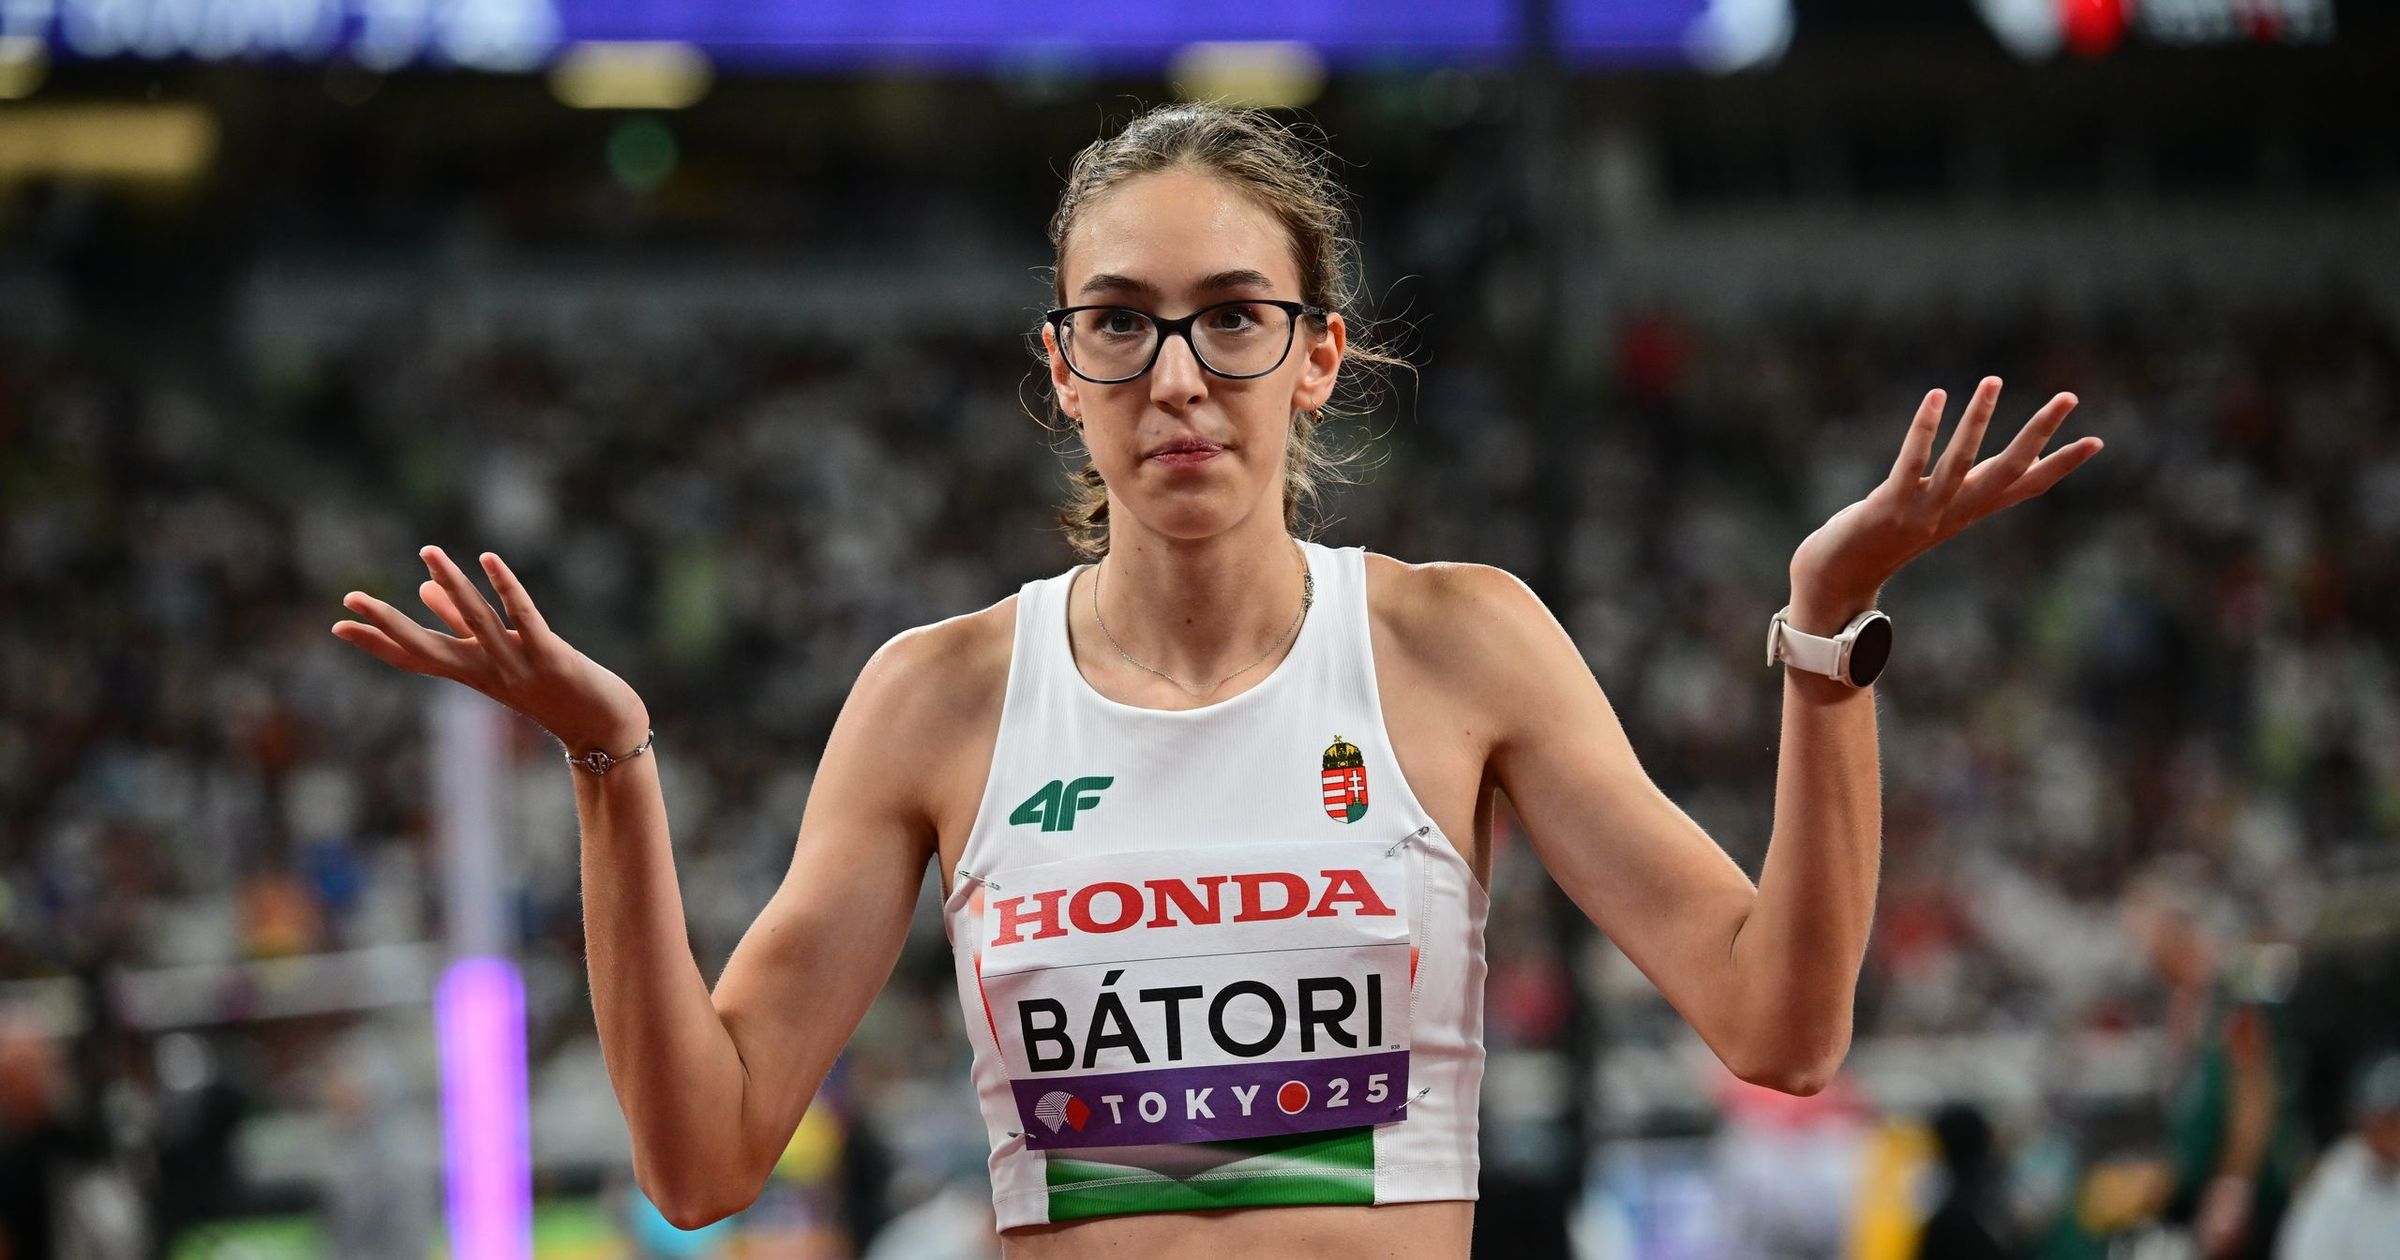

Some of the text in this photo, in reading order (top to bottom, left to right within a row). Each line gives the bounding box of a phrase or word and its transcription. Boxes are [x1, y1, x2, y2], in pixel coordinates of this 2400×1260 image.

[1009, 776, 1115, 832] 4F
[991, 869, 1396, 948] HONDA
[1018, 969, 1382, 1073] BÁTORI
